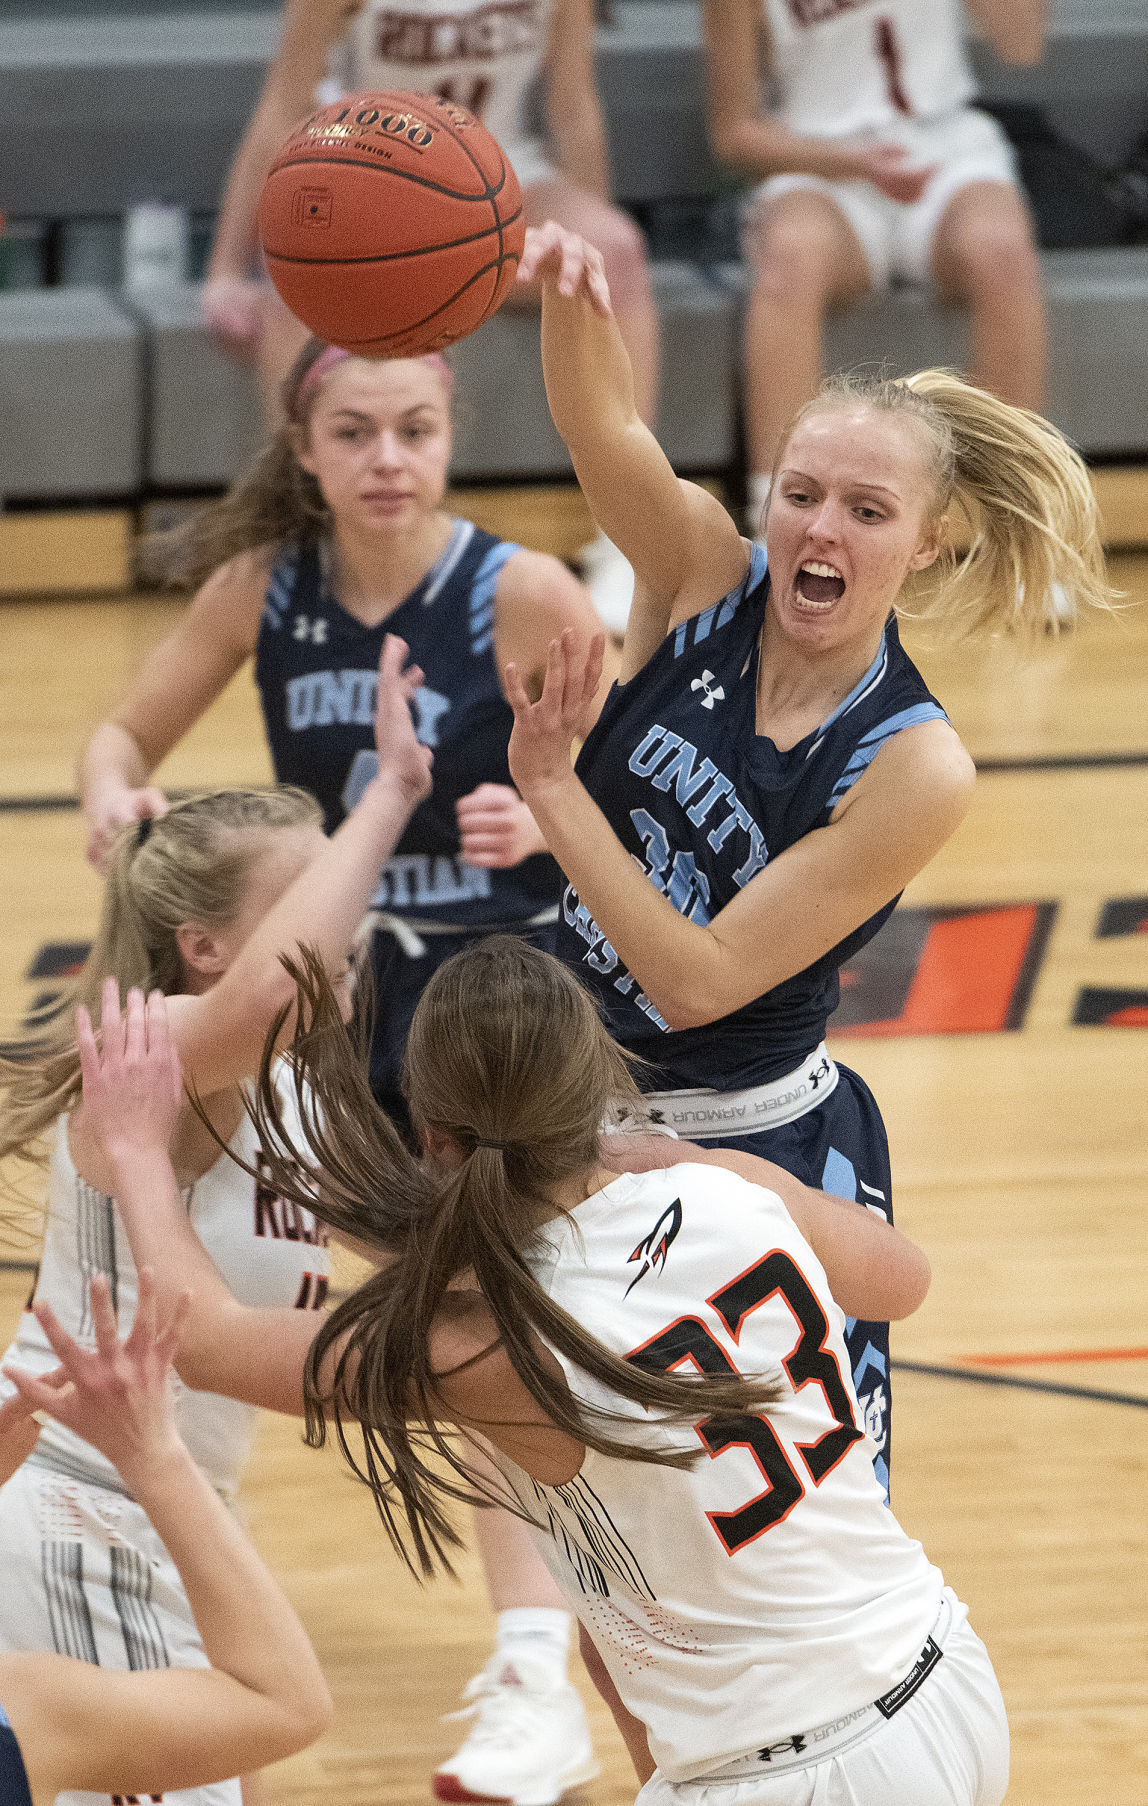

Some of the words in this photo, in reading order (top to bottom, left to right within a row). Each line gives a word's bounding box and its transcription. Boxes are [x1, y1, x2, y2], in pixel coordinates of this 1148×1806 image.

[286, 669, 450, 747] UNIY
[628, 723, 770, 889] UNITY
[754, 1083, 808, 1113] UNDER
[671, 1104, 747, 1124] ARMOUR
[623, 1247, 866, 1558] 33
[904, 1666, 920, 1686] UNDER
[884, 1682, 906, 1706] ARMOUR
